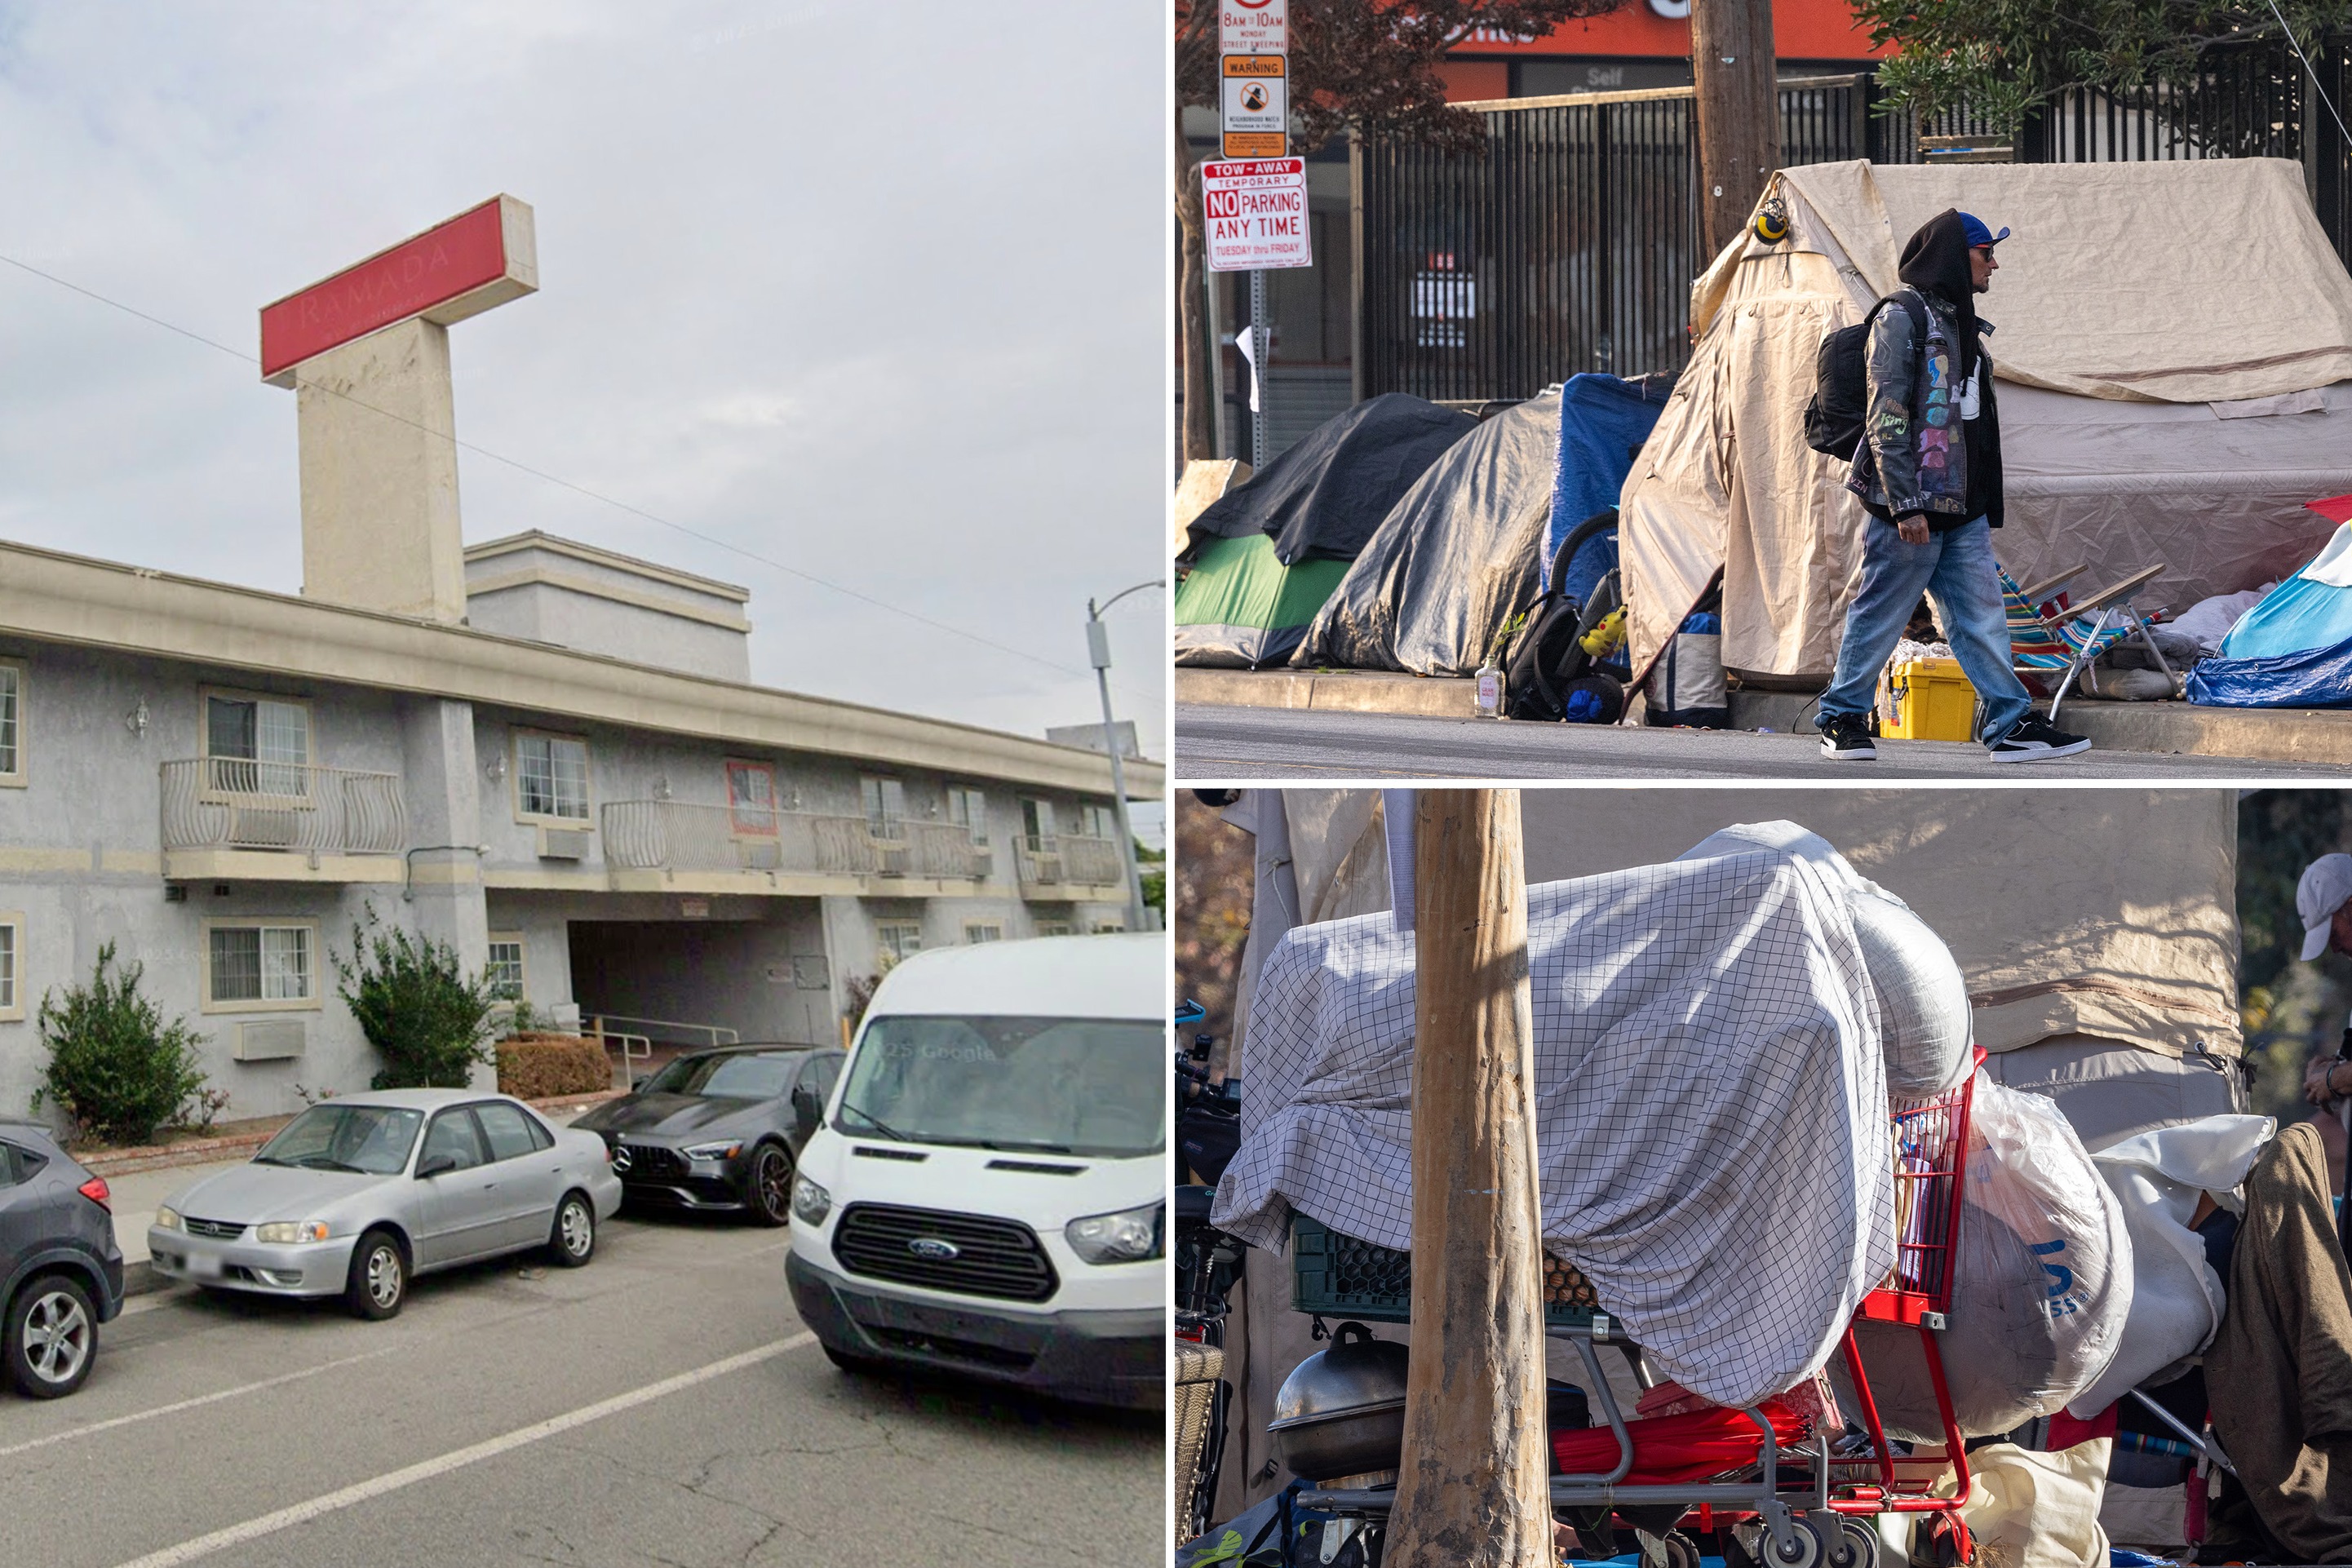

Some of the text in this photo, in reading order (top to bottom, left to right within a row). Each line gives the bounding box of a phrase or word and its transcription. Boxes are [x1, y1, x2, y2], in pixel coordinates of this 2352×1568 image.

[1225, 12, 1246, 27] 8AM
[1257, 12, 1282, 27] 10AM
[1229, 64, 1278, 73] WARNING
[1213, 162, 1291, 176] TOW-AWAY
[1218, 176, 1289, 188] TEMPORARY
[1210, 190, 1301, 217] NO PARKING
[1216, 216, 1300, 239] ANY TIME
[1215, 245, 1251, 256] TUESDAY
[1270, 243, 1300, 254] FRIDAY
[299, 243, 450, 330] RAMADA
[1880, 412, 1908, 435] King
